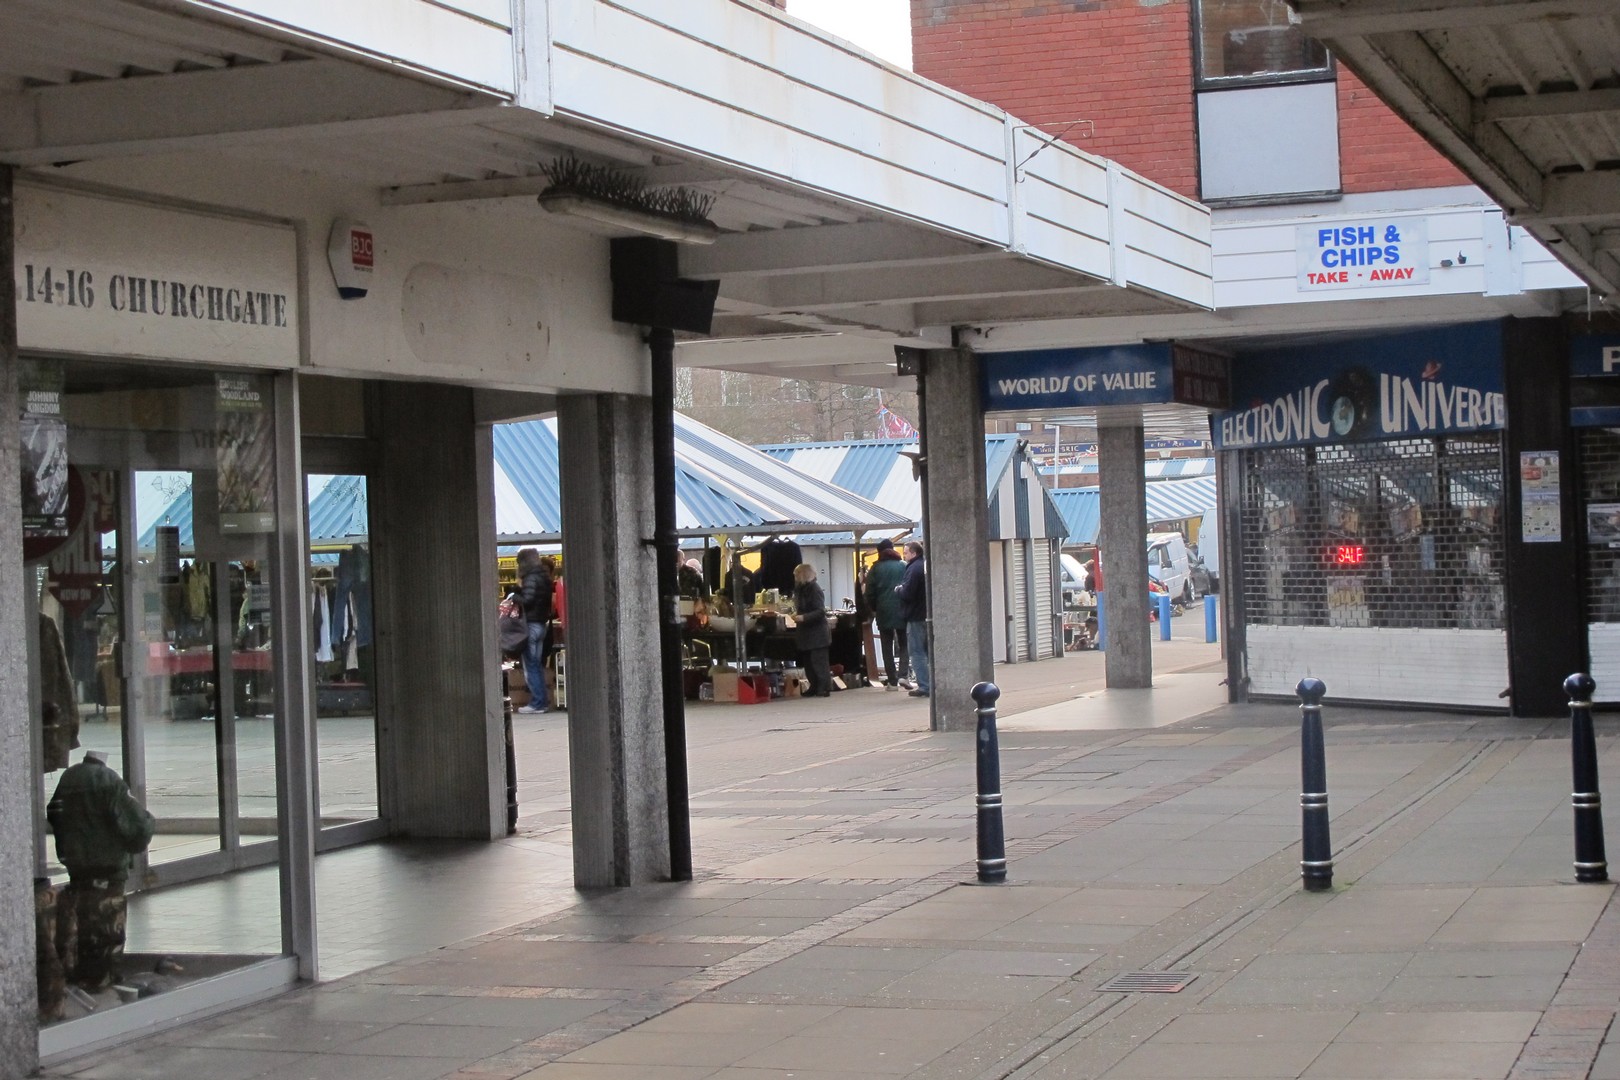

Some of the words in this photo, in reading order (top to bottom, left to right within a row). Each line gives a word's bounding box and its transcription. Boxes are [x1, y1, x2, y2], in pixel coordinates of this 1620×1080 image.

[1317, 226, 1375, 248] FISH
[1383, 224, 1401, 244] &
[352, 236, 373, 256] BJC
[1320, 245, 1400, 268] CHIPS
[1307, 270, 1349, 285] TAKE
[1369, 267, 1415, 282] AWAY
[24, 263, 95, 309] 14-16
[108, 274, 287, 328] CHURCHGATE
[998, 376, 1071, 396] WORLDS
[1073, 374, 1097, 392] OF
[1102, 371, 1157, 391] VALUE
[27, 390, 60, 403] JOHNNY
[219, 390, 260, 401] WOODLAND
[27, 402, 60, 414] KINGDOM
[1221, 379, 1331, 447] ELECTRONIC
[1380, 373, 1505, 433] UNIVERSE
[1338, 546, 1364, 563] SALE
[60, 588, 79, 601] NOW
[80, 588, 92, 601] ON
